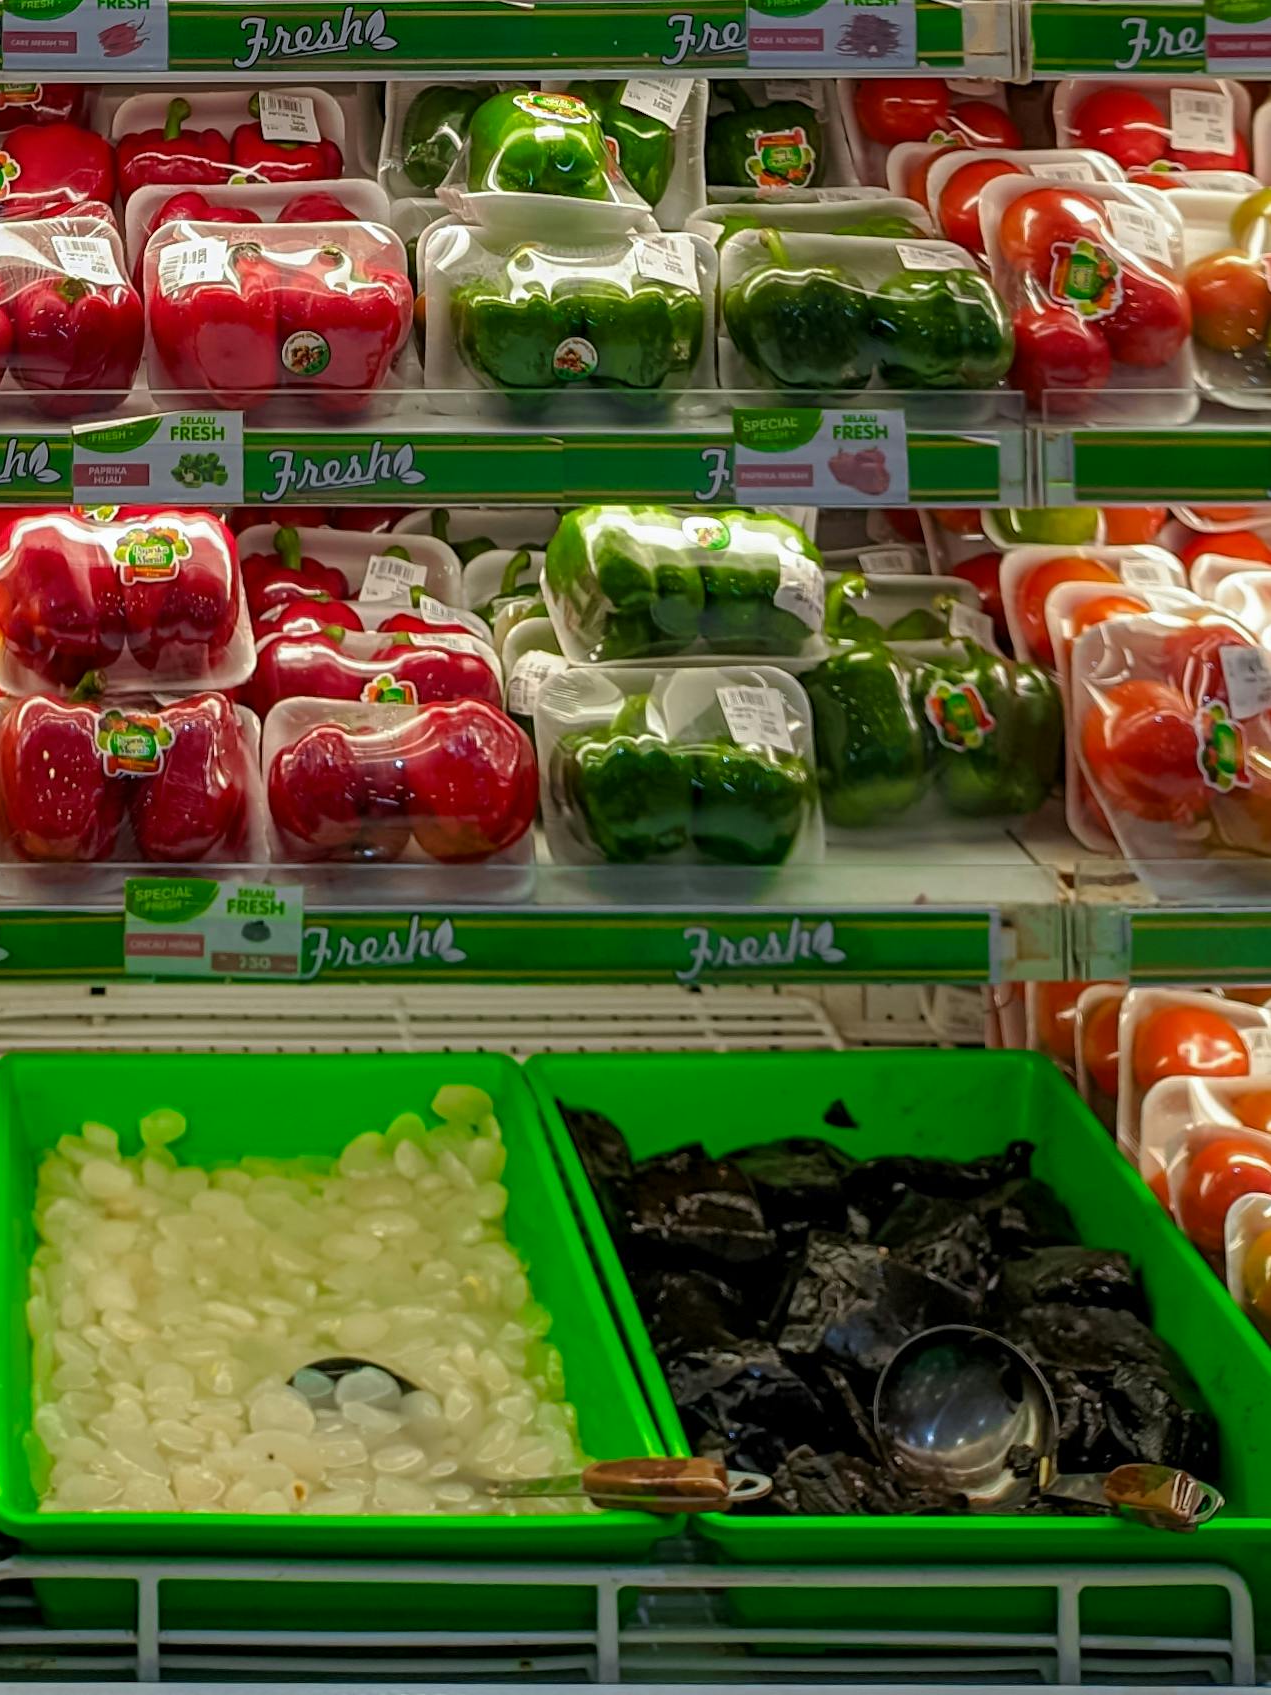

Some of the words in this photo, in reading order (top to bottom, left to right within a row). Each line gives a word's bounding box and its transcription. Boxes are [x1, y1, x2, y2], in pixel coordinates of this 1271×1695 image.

[10, 39, 32, 48] CABE
[233, 7, 365, 69] Fresh
[661, 13, 746, 65] Fre
[752, 36, 774, 45] CABE
[1115, 17, 1204, 70] Fre
[179, 416, 216, 426] SELALU
[742, 417, 798, 433] SPECIAL
[841, 414, 877, 424] SELALU
[91, 430, 127, 442] FRESH
[169, 425, 225, 441] FRESH
[832, 423, 889, 440] FRESH
[88, 466, 128, 476] PAPRIKA
[261, 441, 397, 501] Fresh
[93, 475, 122, 485] HIJAU
[132, 543, 169, 558] Paprika
[135, 554, 167, 566] Merah
[134, 886, 193, 902] SPECIAL
[226, 898, 285, 916] FRESH
[301, 916, 429, 980] Fresh
[676, 917, 817, 981] Fresh
